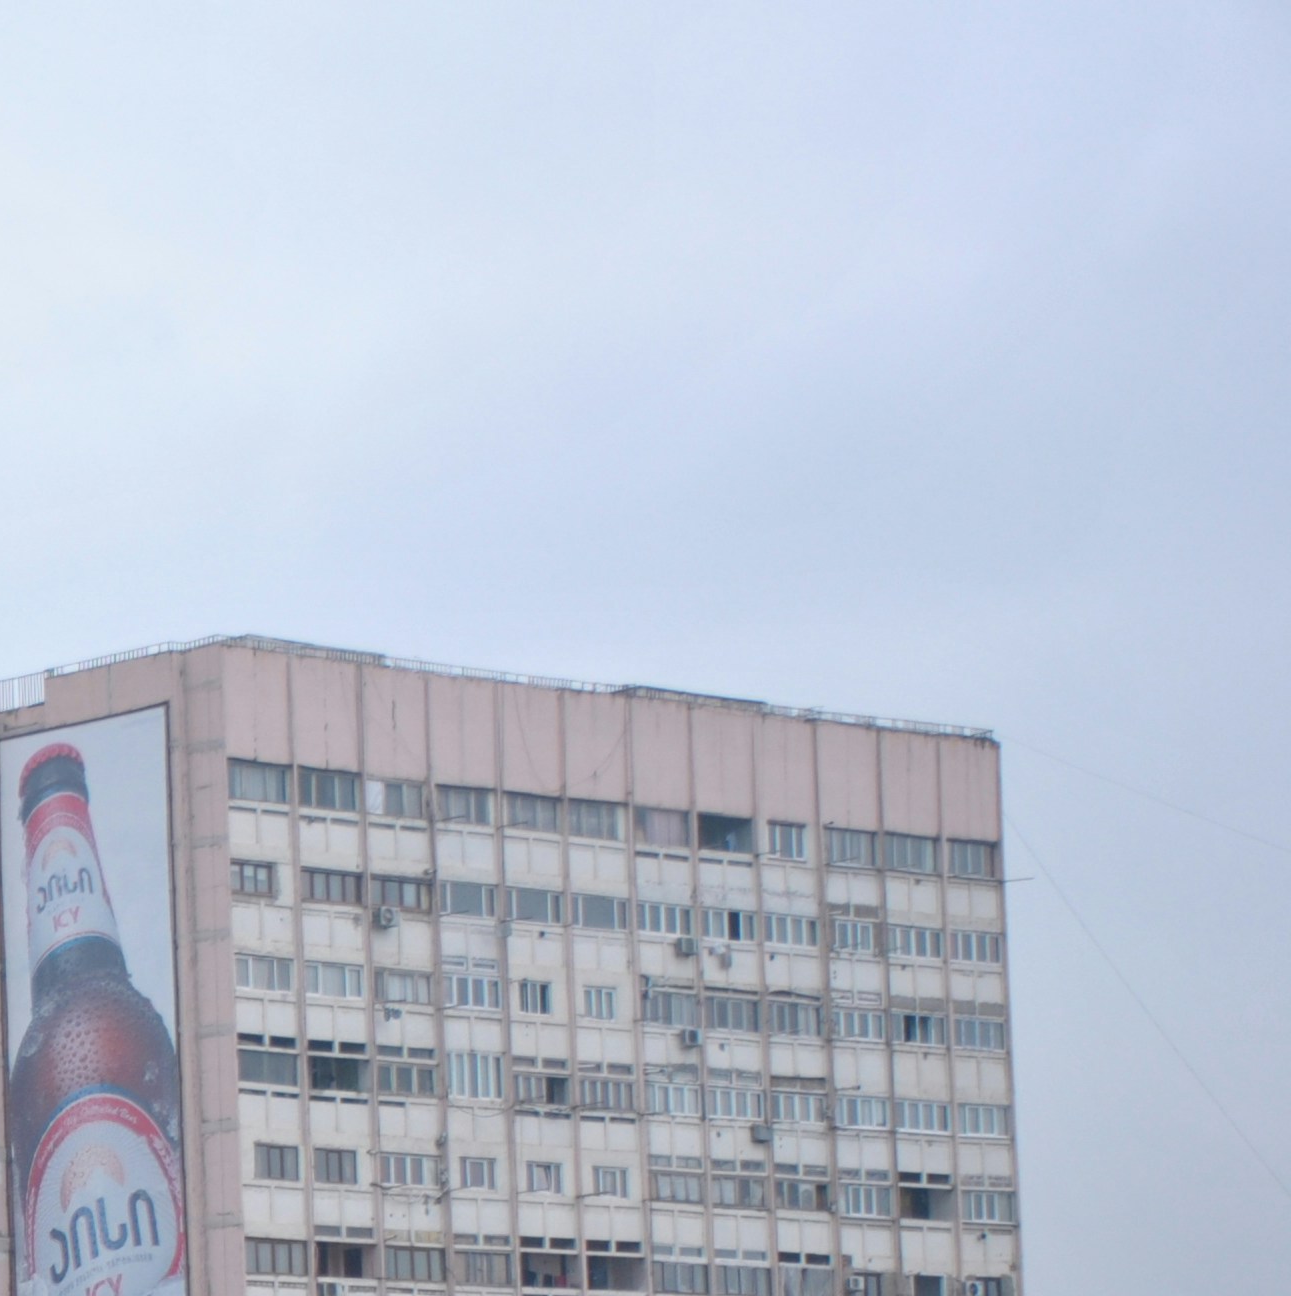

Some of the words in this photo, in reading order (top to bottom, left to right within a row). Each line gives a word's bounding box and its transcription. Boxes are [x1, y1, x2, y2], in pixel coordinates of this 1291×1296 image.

[37, 867, 94, 914] აისი
[53, 905, 80, 933] ICY
[49, 1188, 160, 1285] აისი
